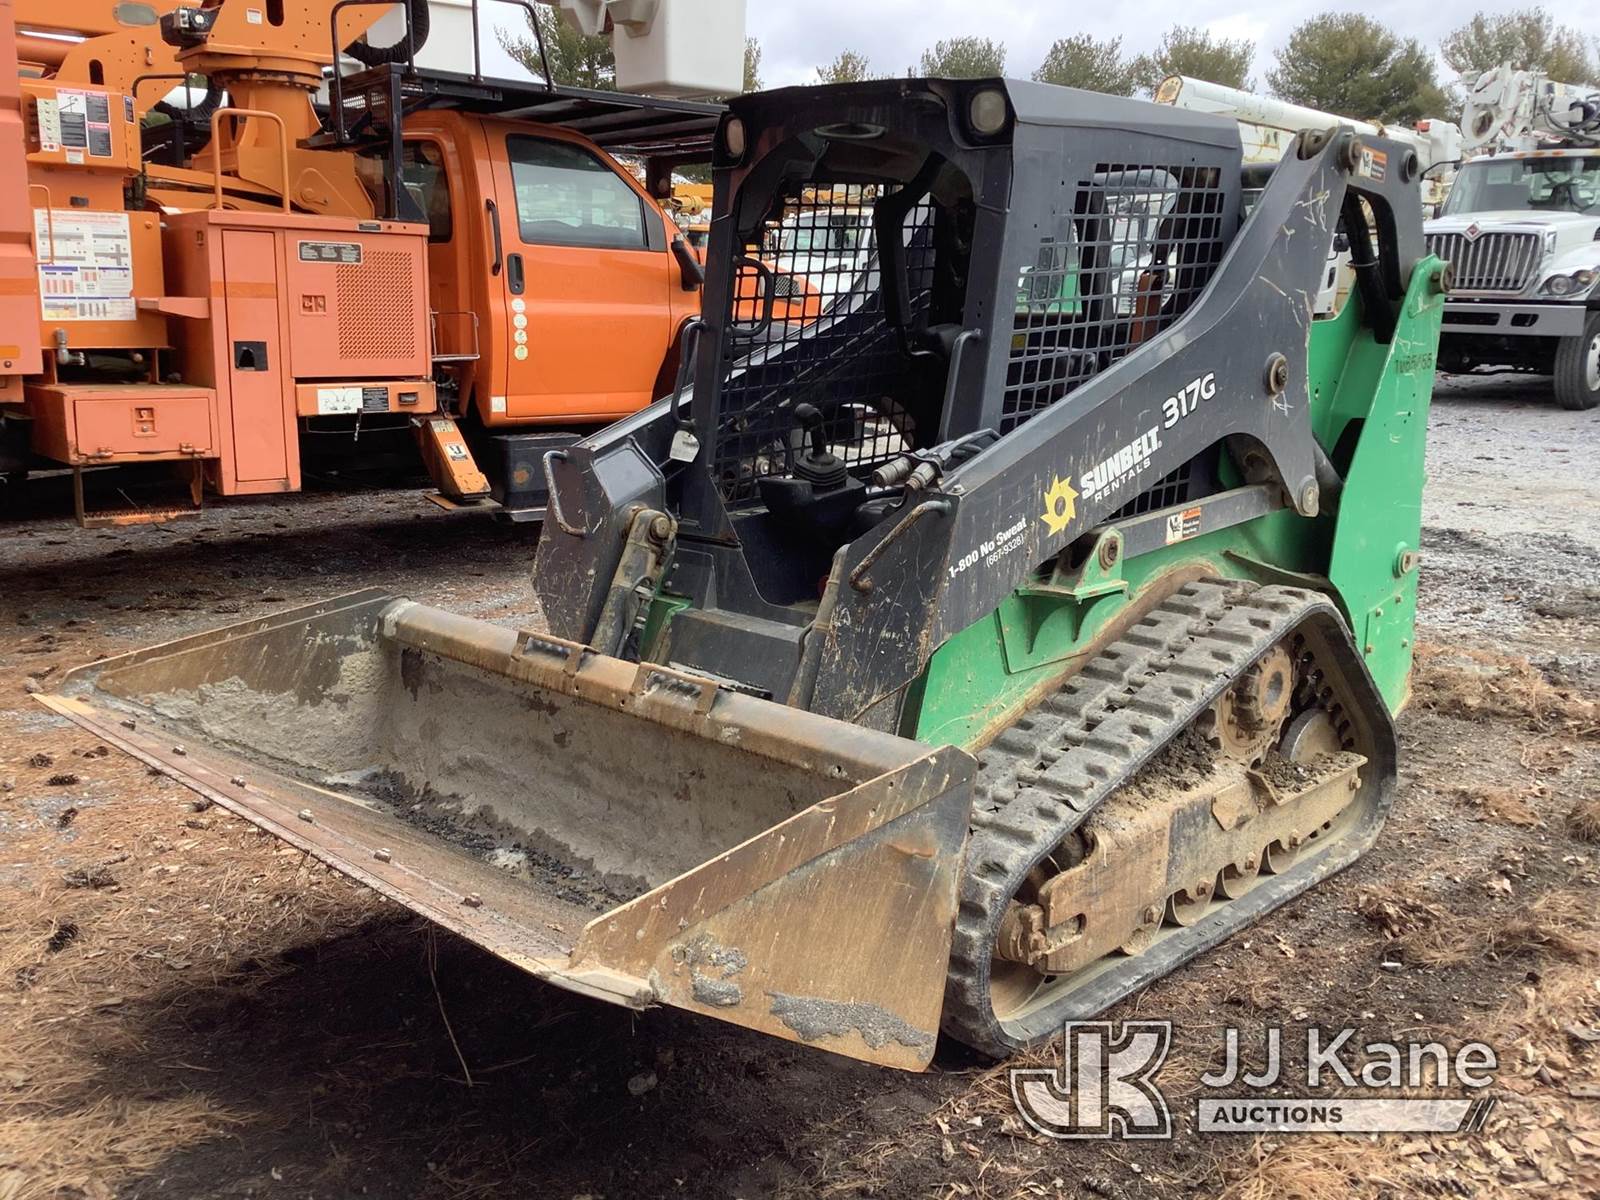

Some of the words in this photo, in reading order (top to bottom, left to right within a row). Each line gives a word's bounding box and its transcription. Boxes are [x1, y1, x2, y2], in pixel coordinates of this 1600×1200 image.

[1162, 372, 1216, 429] 317G
[1093, 457, 1151, 503] RENTALS
[948, 550, 979, 578] 1-800
[979, 541, 995, 557] No
[995, 517, 1027, 546] Sweat
[986, 533, 1025, 568] (667-9328)
